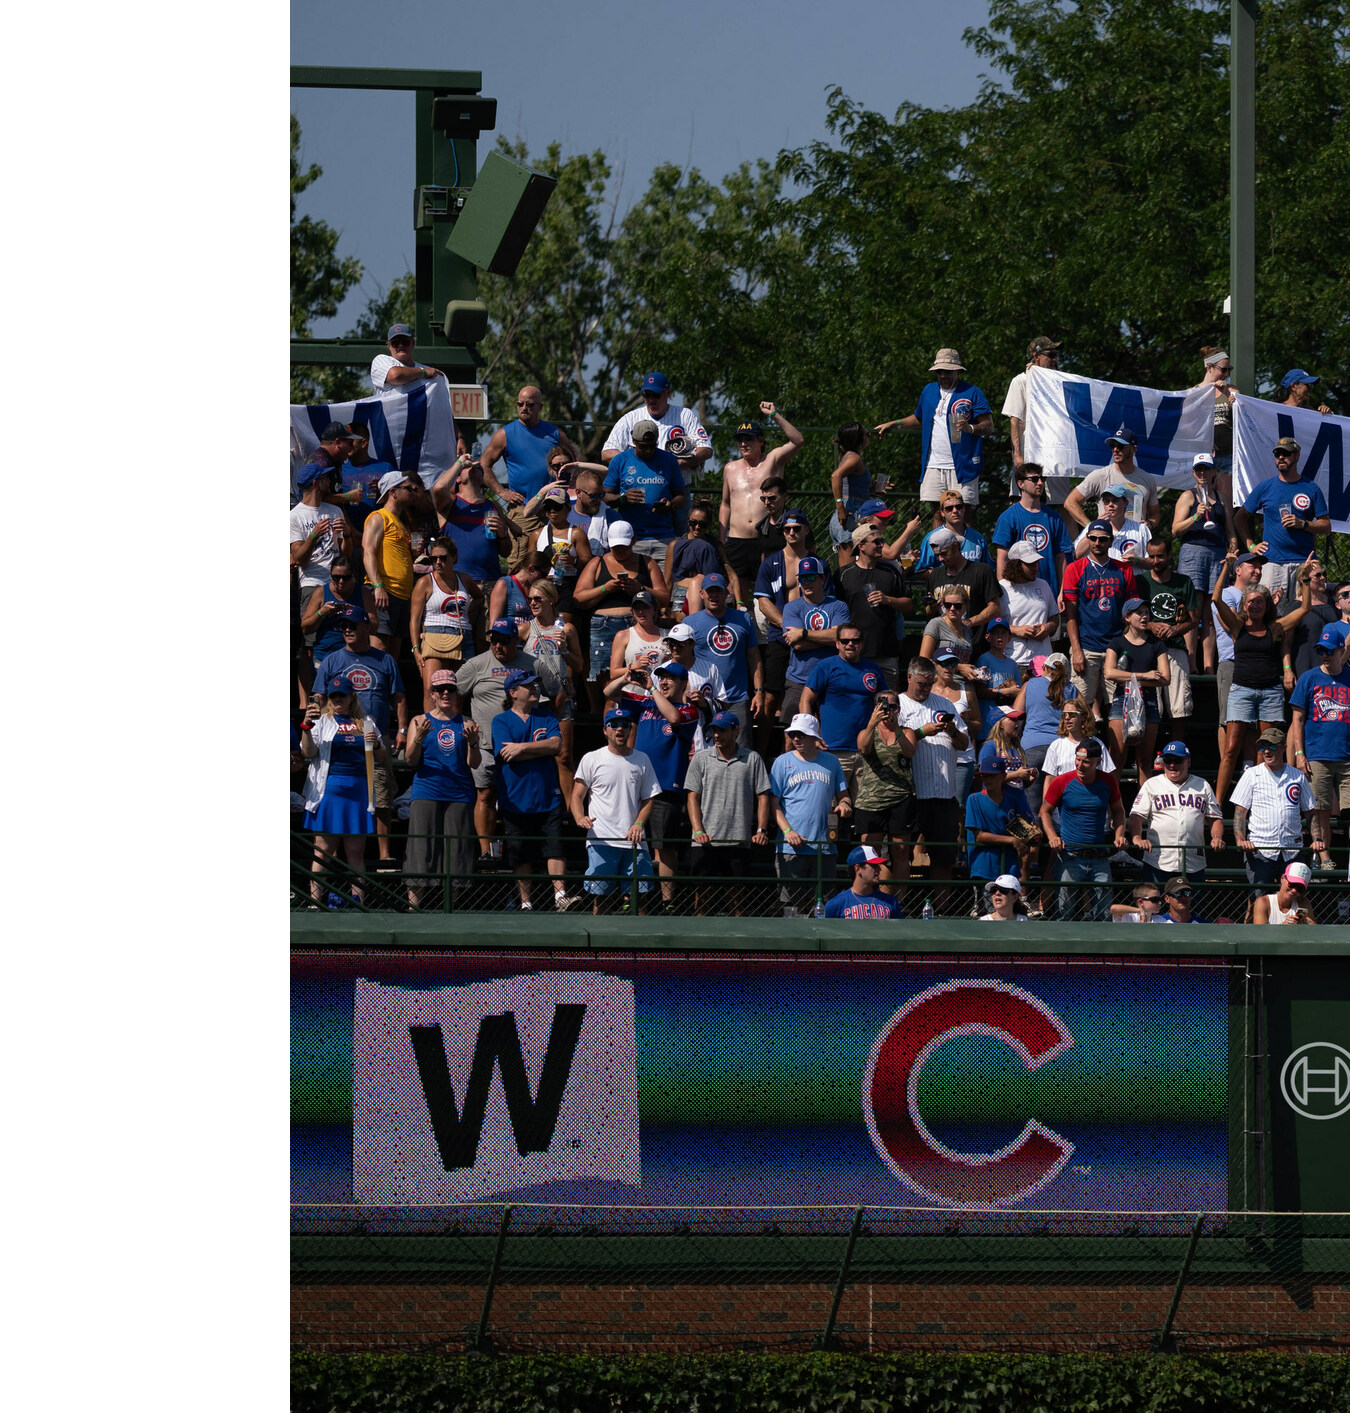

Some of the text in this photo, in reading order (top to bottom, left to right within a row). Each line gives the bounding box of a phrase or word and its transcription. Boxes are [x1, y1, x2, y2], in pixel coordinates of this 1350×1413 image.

[453, 392, 481, 415] EXIT
[307, 386, 427, 470] W
[1063, 381, 1185, 476] W
[637, 476, 665, 486] Condor
[1085, 586, 1122, 599] CUBS
[1086, 578, 1120, 587] CHICAGO
[1154, 793, 1207, 815] CHICAGO
[844, 903, 891, 919] CHICAGO
[409, 1003, 586, 1172] W
